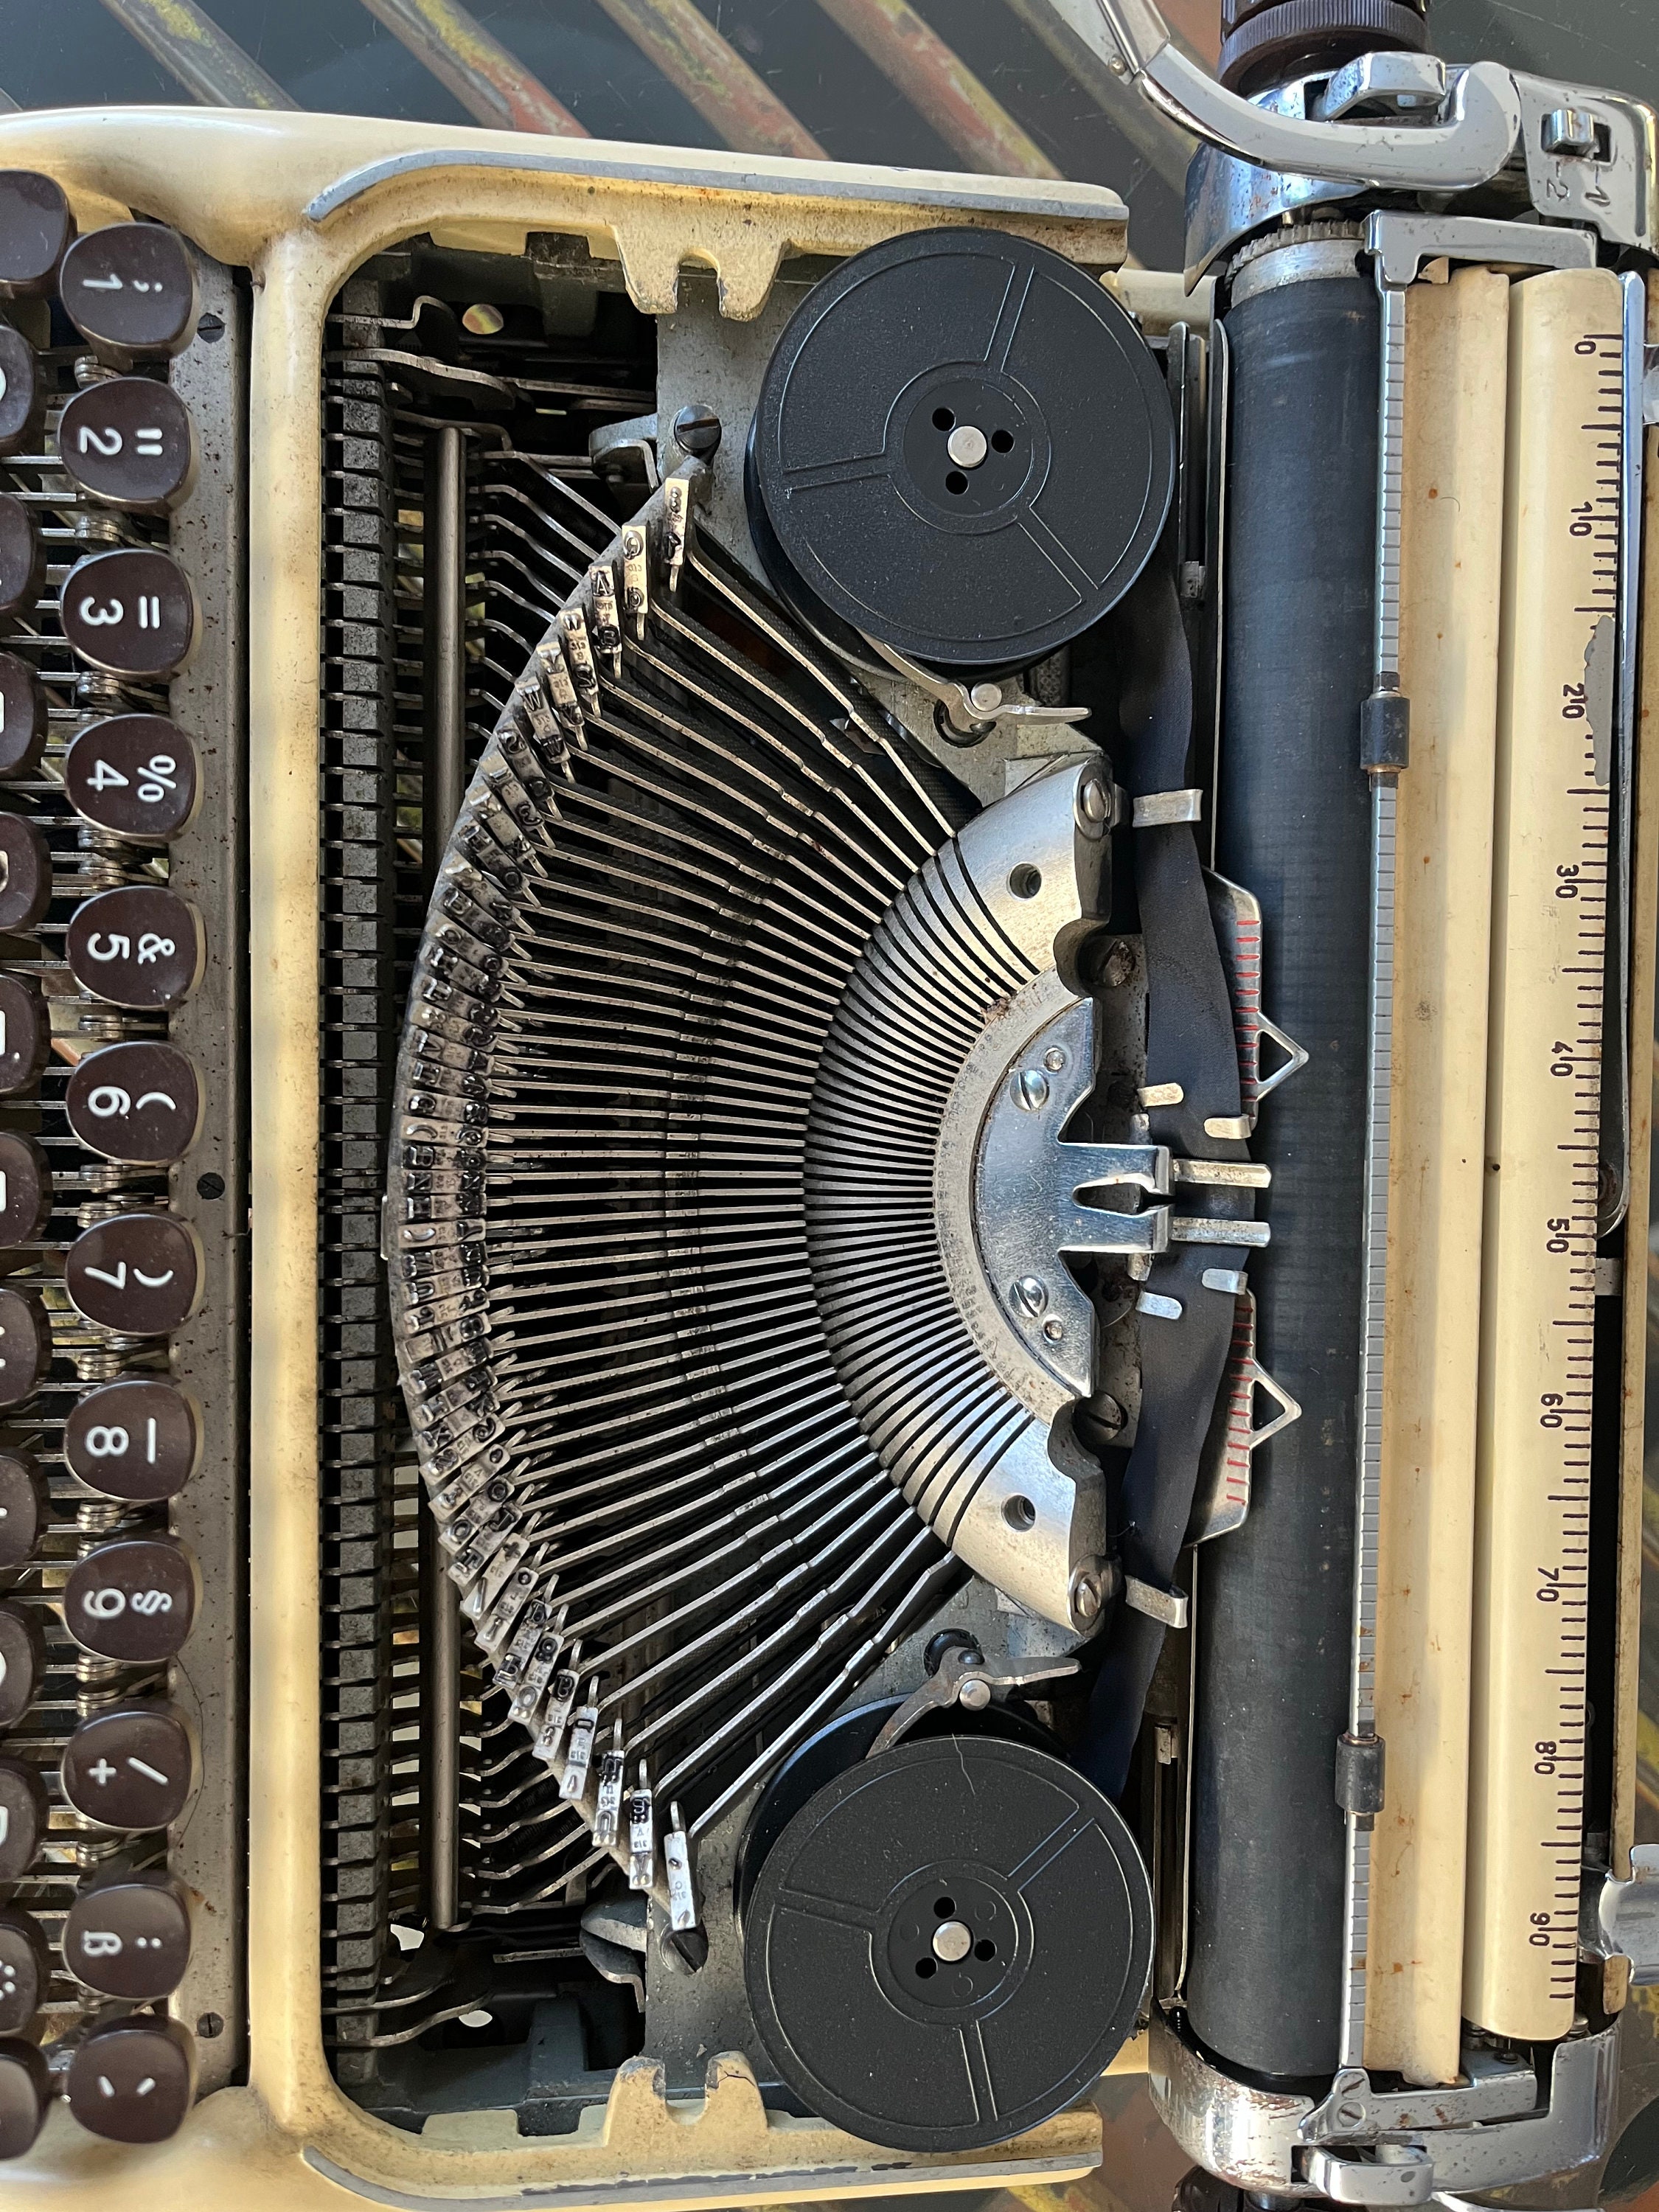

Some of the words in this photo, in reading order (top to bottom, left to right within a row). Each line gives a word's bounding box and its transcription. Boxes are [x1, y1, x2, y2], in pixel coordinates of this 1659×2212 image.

[1546, 177, 1570, 202] 2
[1585, 185, 1611, 207] 1
[83, 274, 123, 290] 1
[1574, 341, 1596, 355] 0
[79, 427, 122, 456] 2
[1568, 501, 1593, 536] 10
[80, 597, 124, 626] 3
[1562, 684, 1585, 719] 20
[86, 759, 129, 792] 4
[137, 754, 176, 802] %
[1555, 863, 1579, 899] 30
[87, 932, 130, 961] 5
[138, 933, 175, 964] &
[1550, 1041, 1573, 1077] 40
[88, 1085, 131, 1116] 6
[1545, 1218, 1570, 1253] 50
[85, 1261, 126, 1290] 7
[1540, 1393, 1563, 1428] 60
[85, 1425, 129, 1458] 8
[1536, 1567, 1559, 1602] 70
[83, 1587, 125, 1618] 9
[132, 1589, 172, 1616] §
[1534, 1740, 1558, 1775] 80
[1529, 1911, 1551, 1947] 90
